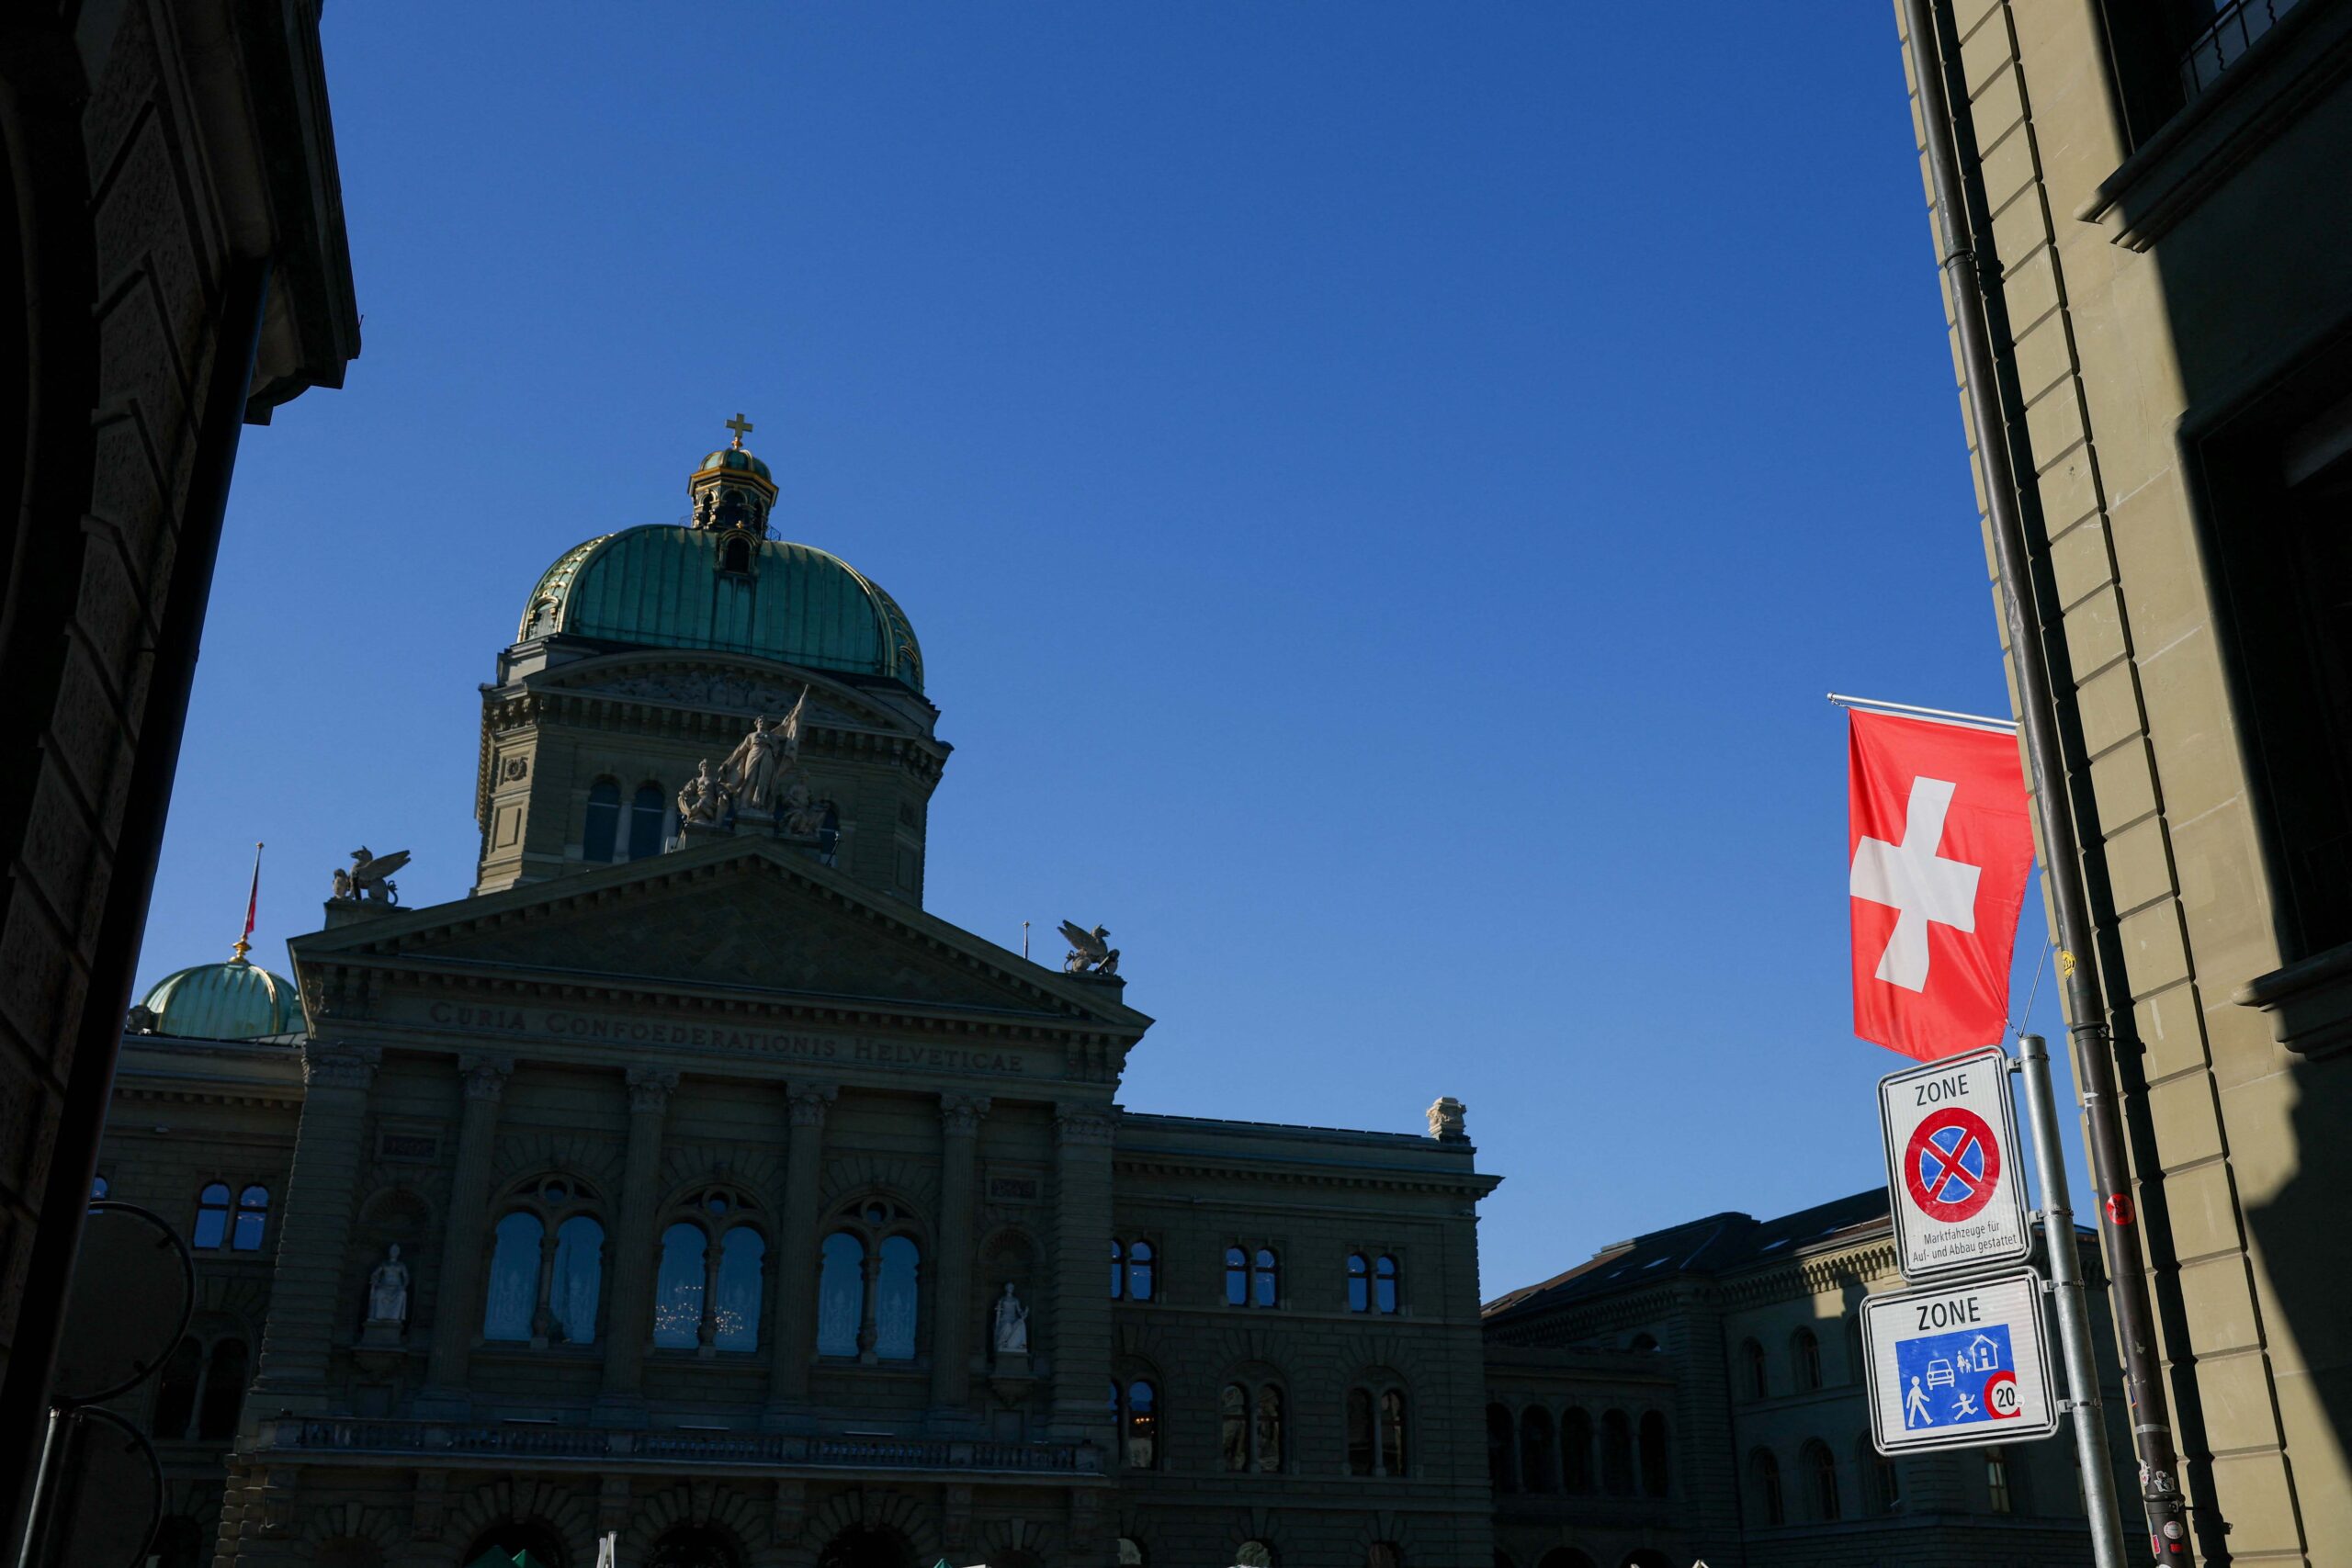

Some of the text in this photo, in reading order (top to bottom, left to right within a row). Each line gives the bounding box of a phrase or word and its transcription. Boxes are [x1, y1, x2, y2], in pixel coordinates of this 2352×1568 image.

[429, 1000, 1023, 1073] CURIA CONFOEDERATIONIS HELVETICAE
[1915, 1074, 1970, 1107] ZONE
[1913, 1234, 2018, 1263] Auf- und Abbau gestattet
[1924, 1221, 2000, 1246] Marktfahzeuge für
[1916, 1296, 1981, 1331] ZONE
[1996, 1386, 2016, 1408] 20
